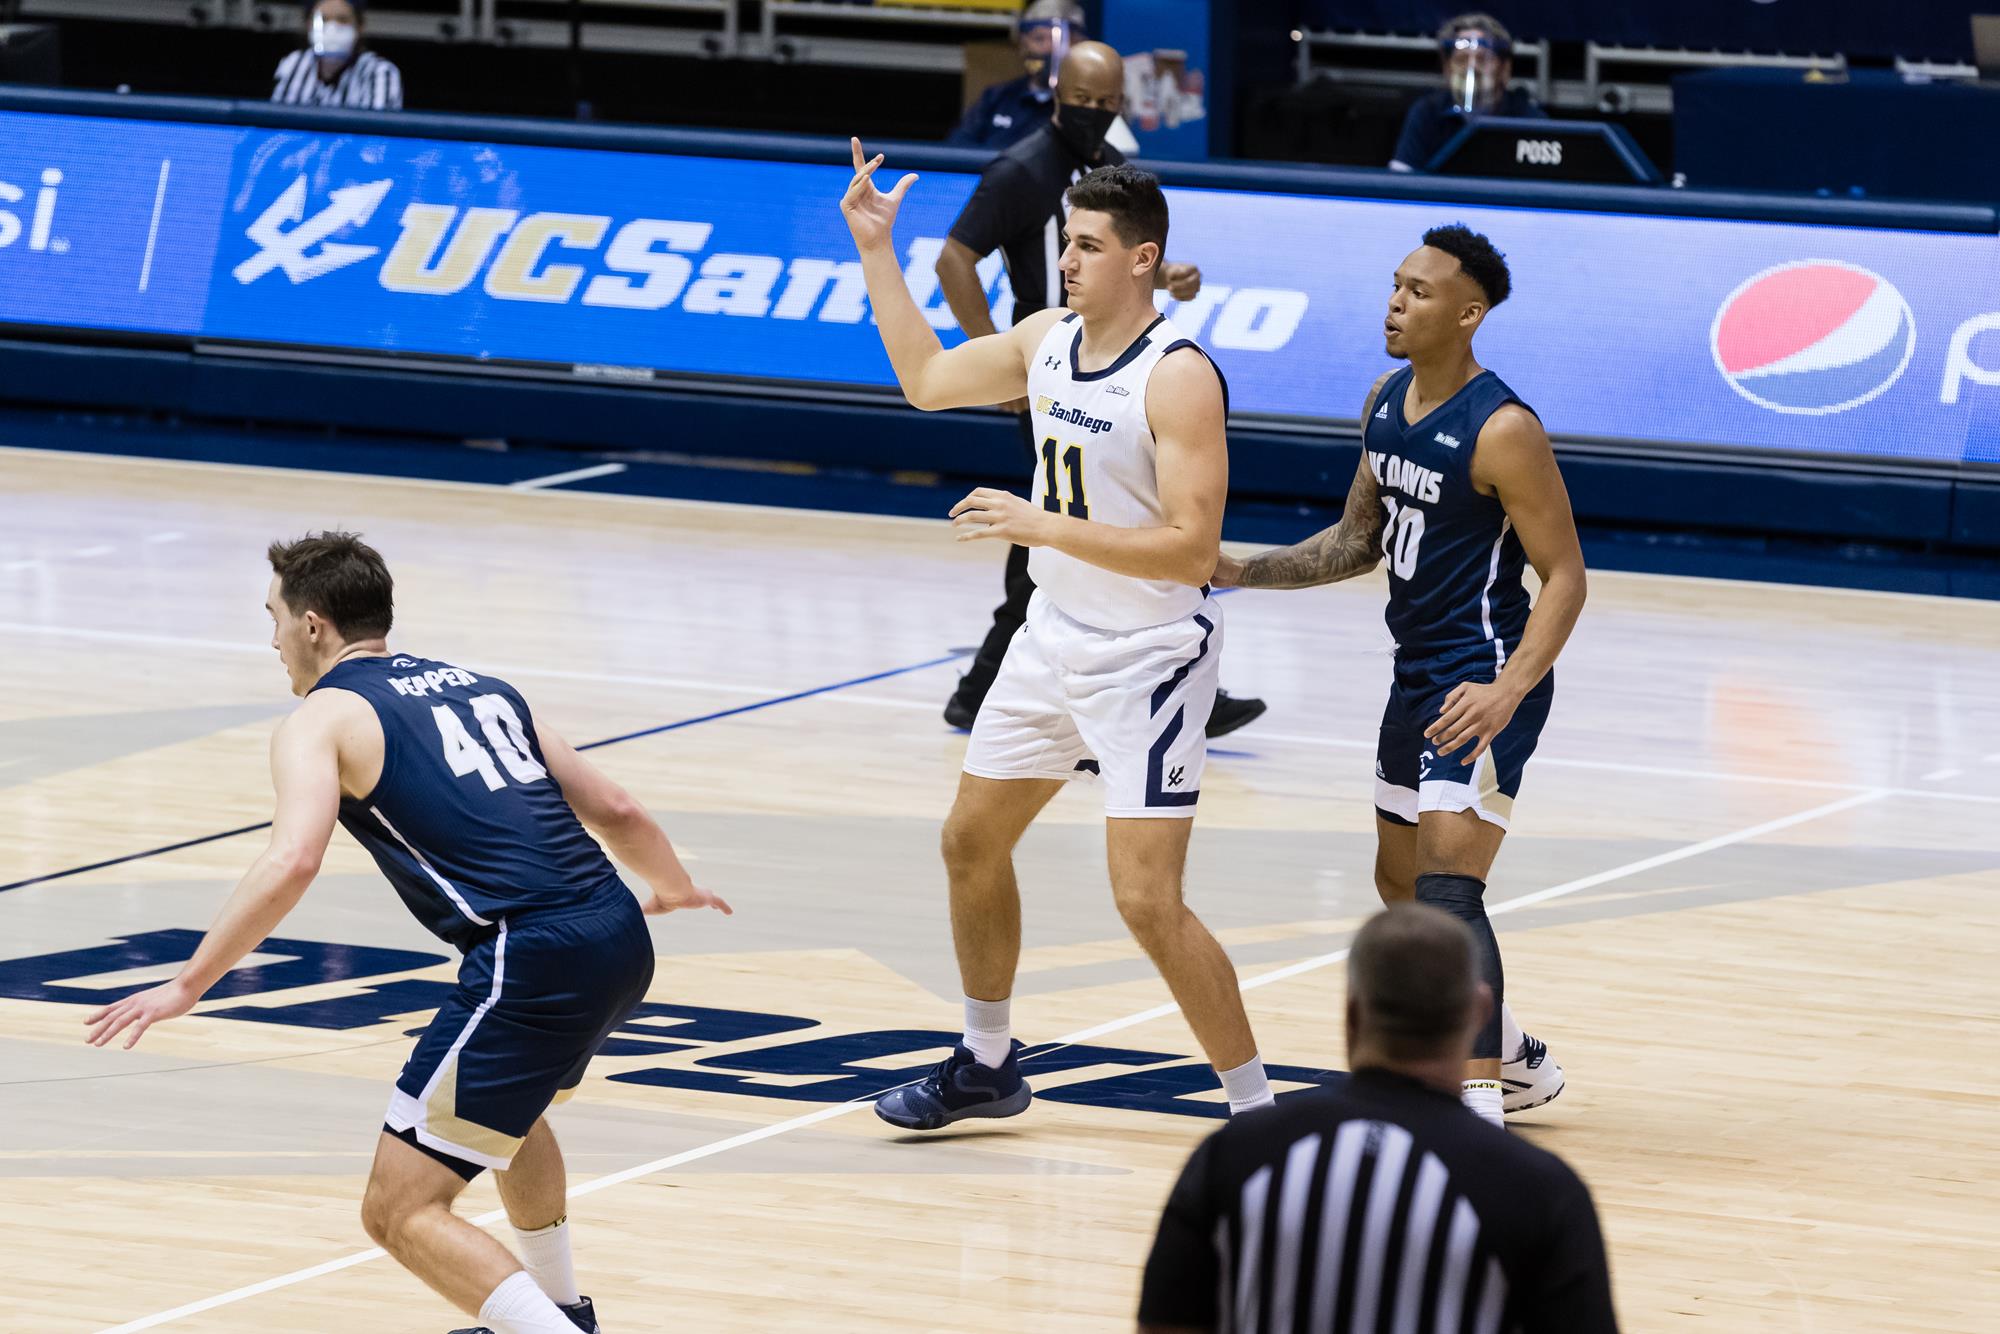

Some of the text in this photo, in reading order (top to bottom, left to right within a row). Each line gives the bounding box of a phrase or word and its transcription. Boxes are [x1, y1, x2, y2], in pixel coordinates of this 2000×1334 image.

[1516, 139, 1562, 165] POSS
[1042, 436, 1091, 520] 11
[1386, 454, 1444, 504] DAVIS
[430, 693, 548, 792] 40
